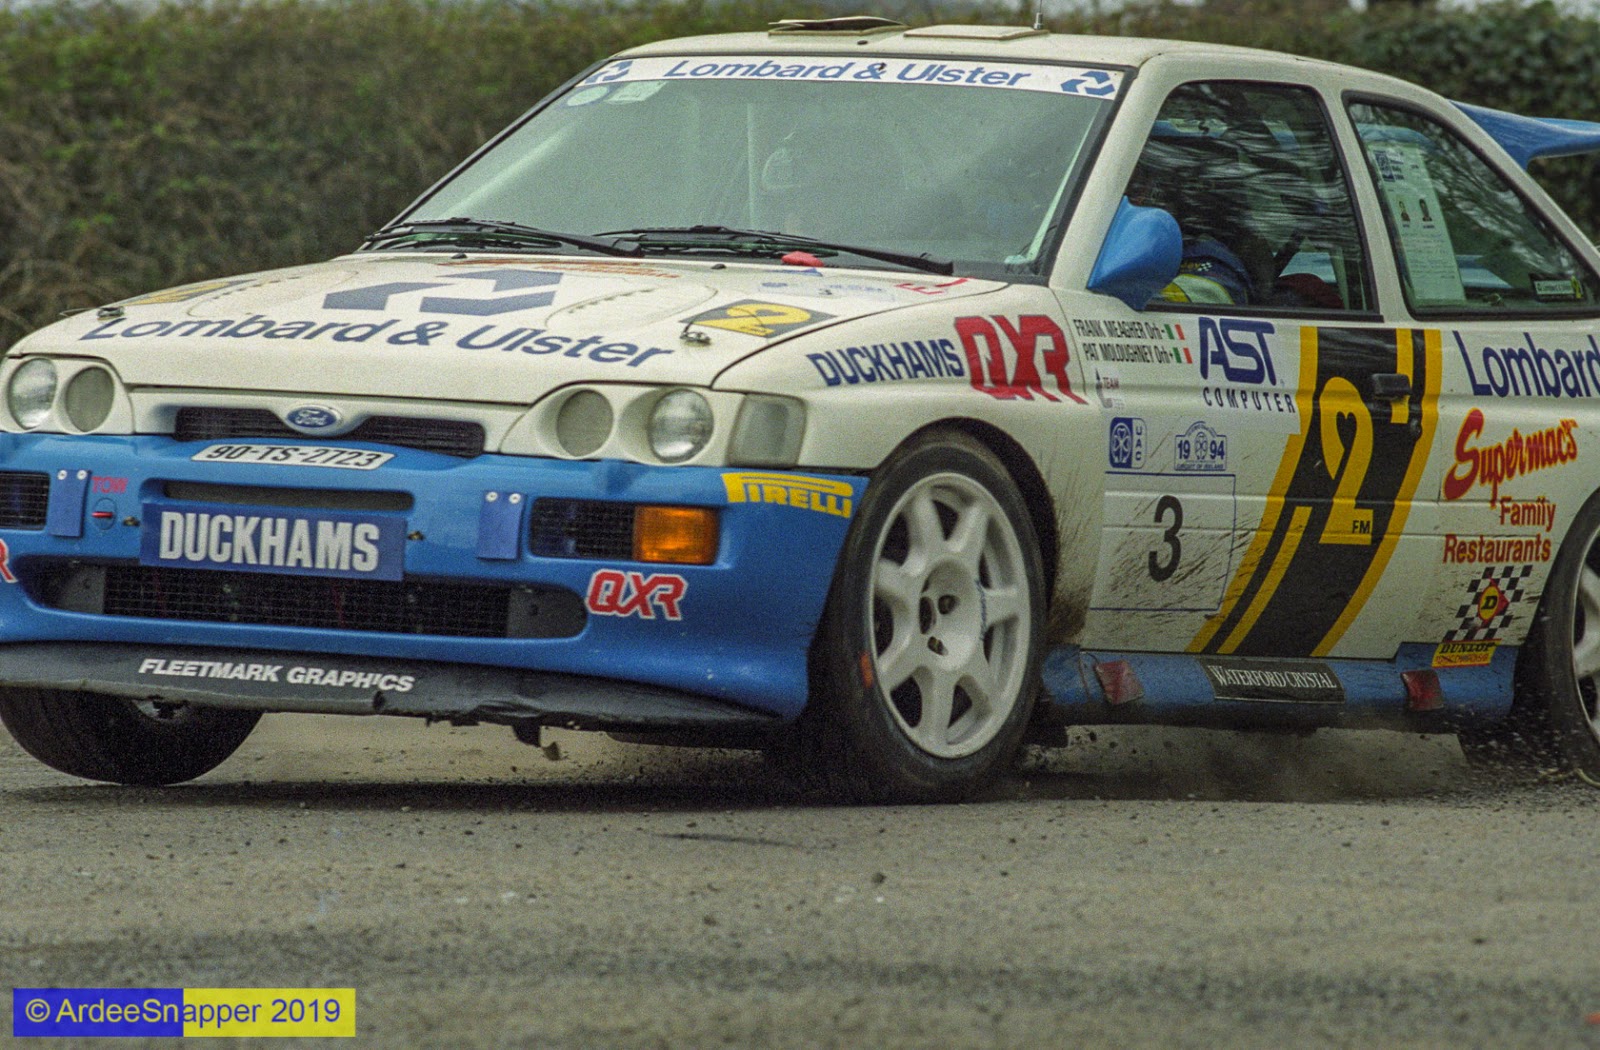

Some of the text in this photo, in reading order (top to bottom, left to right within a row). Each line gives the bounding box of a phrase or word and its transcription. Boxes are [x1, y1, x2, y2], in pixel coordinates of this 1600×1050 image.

[663, 60, 1031, 86] Lombard & Ulster
[79, 315, 674, 369] Lombard & Ulster
[1073, 319, 1105, 337] FRANK
[1104, 320, 1147, 339] MEAGHER
[807, 314, 1088, 404] DUCKHAMS QXR
[1083, 343, 1099, 361] PAT
[1199, 317, 1276, 386] AST
[1103, 377, 1119, 389] TEAM
[1202, 387, 1295, 413] COMPUTER
[295, 410, 328, 426] Ford
[207, 446, 381, 467] 90-TS-2723
[92, 476, 128, 493] TOW
[720, 472, 852, 518] PIRELLI
[1352, 520, 1371, 534] FM
[1500, 495, 1556, 532] Family
[159, 511, 380, 572] DUCKHAMS
[1149, 495, 1183, 582] 3
[1442, 533, 1552, 564] Restaurants
[586, 568, 688, 620] QXR
[138, 659, 415, 692] FLEETMARK GRAPHICS
[1207, 664, 1337, 689] WATERFORD CRYSTAL
